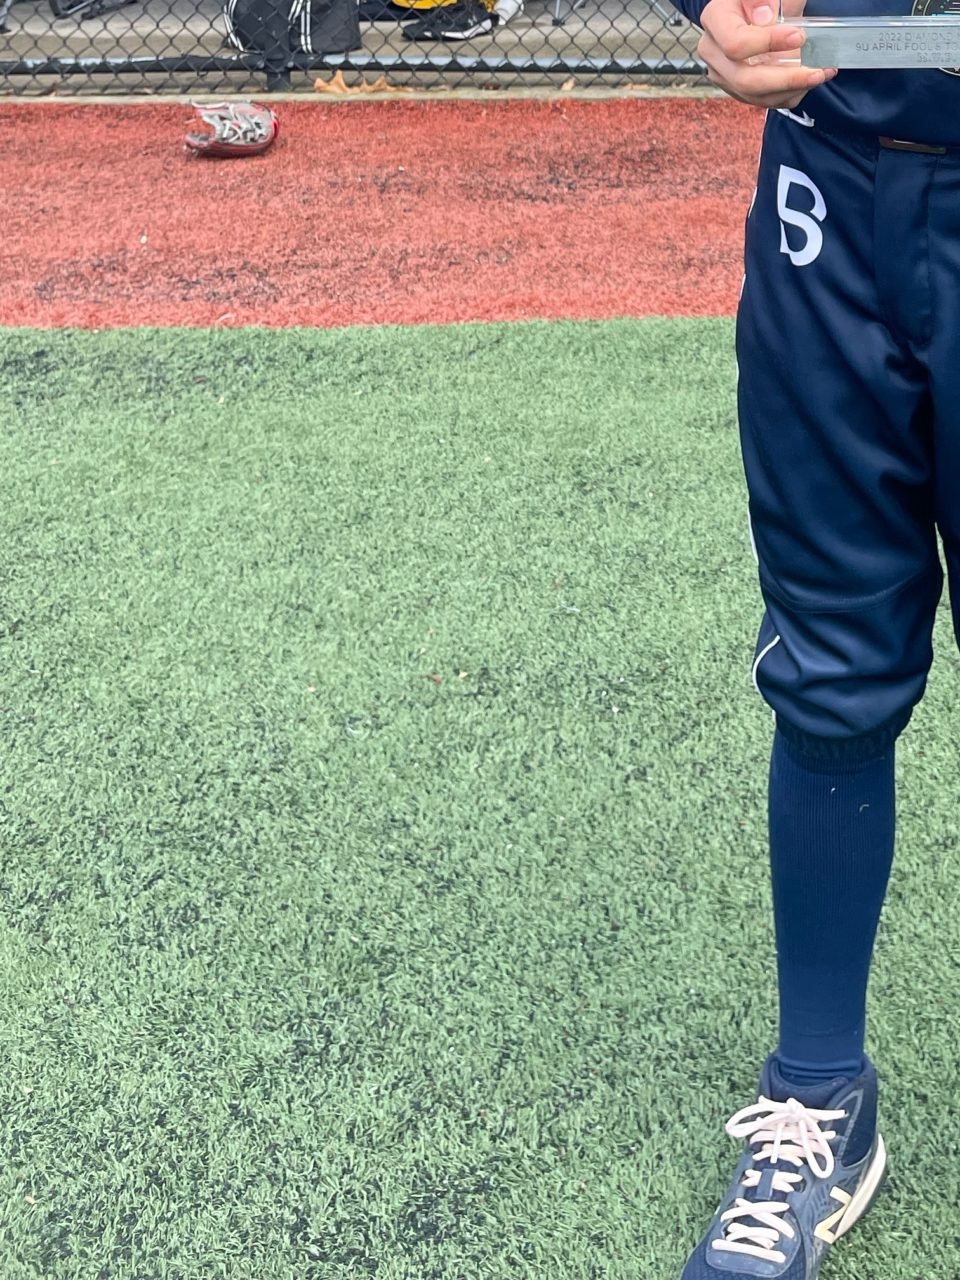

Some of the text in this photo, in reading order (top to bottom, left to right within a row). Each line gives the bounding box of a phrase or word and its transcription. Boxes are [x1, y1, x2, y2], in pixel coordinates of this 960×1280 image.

[878, 32, 902, 42] 2022
[872, 43, 900, 52] APRIL
[777, 164, 827, 266] B
